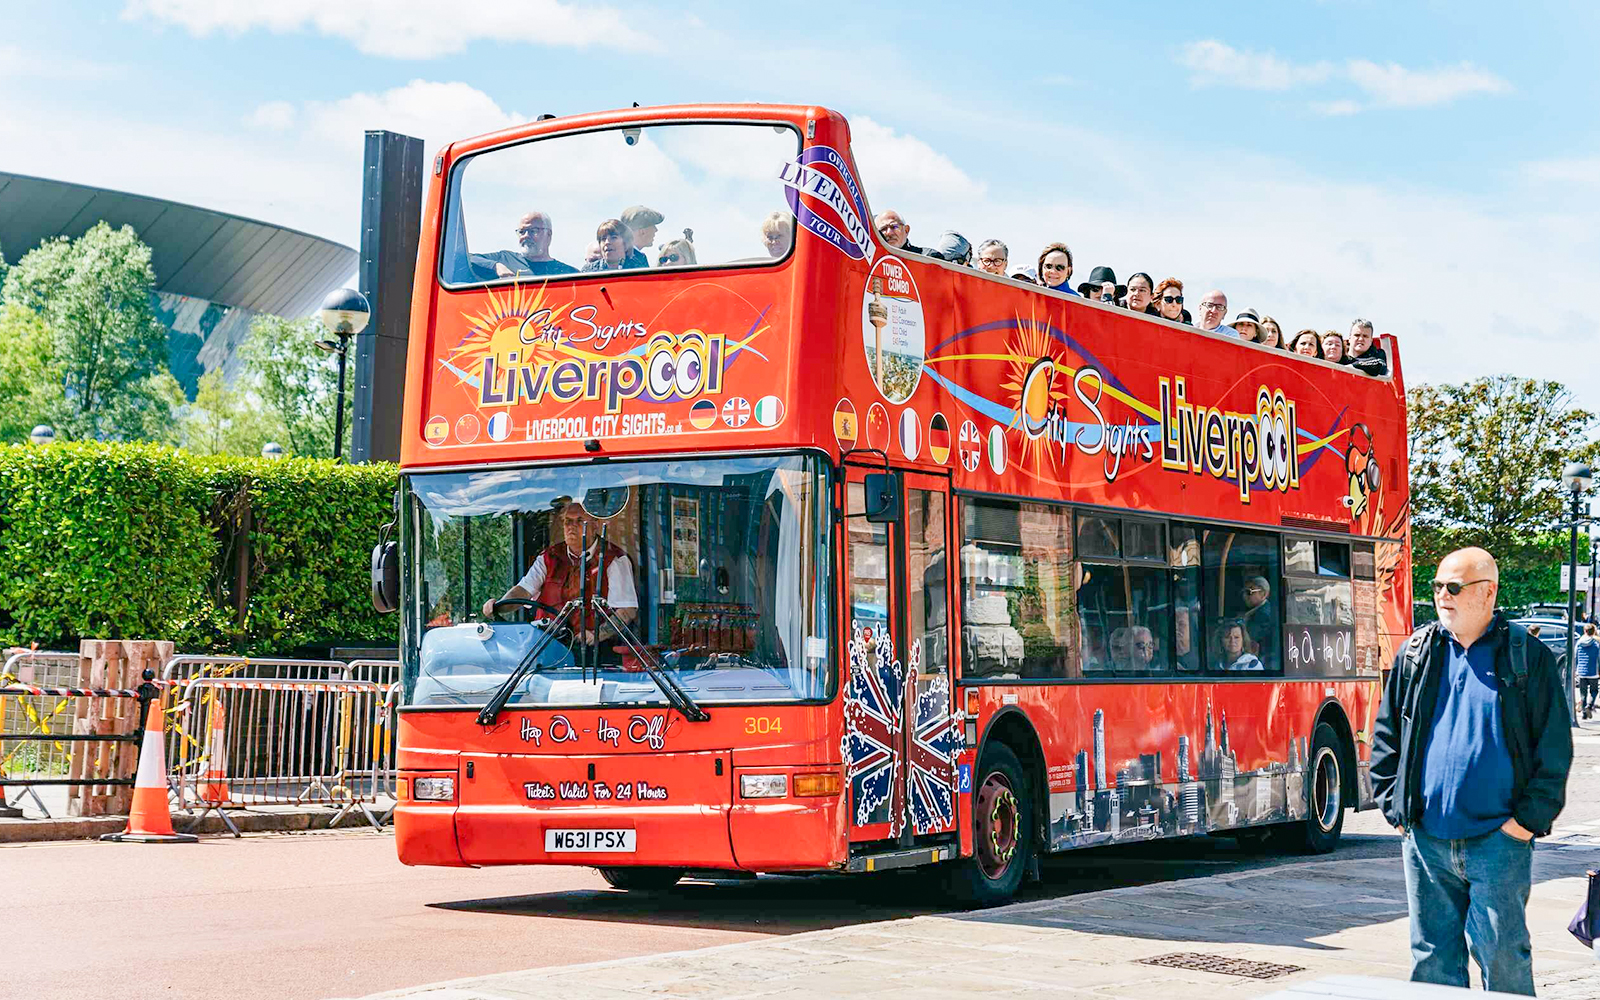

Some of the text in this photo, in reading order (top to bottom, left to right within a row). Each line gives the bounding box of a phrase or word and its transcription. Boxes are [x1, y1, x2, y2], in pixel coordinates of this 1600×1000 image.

[828, 151, 860, 202] OFFICIAL
[778, 162, 873, 259] LIVERPOOL
[810, 216, 842, 245] TOUR
[882, 262, 903, 280] TOWER
[888, 277, 909, 295] COMBO
[520, 305, 648, 351] City Sights
[480, 329, 726, 414] Liverpool
[526, 416, 588, 441] LIVERPOOL
[592, 414, 620, 437] CITY
[1020, 356, 1154, 484] City Sights
[1158, 375, 1300, 504] Liverpool
[549, 714, 579, 744] On
[628, 714, 665, 750] Off
[744, 717, 783, 734] 304
[523, 781, 668, 800] Tickets Valid For 24 Hours
[554, 831, 626, 849] W631 PSX
